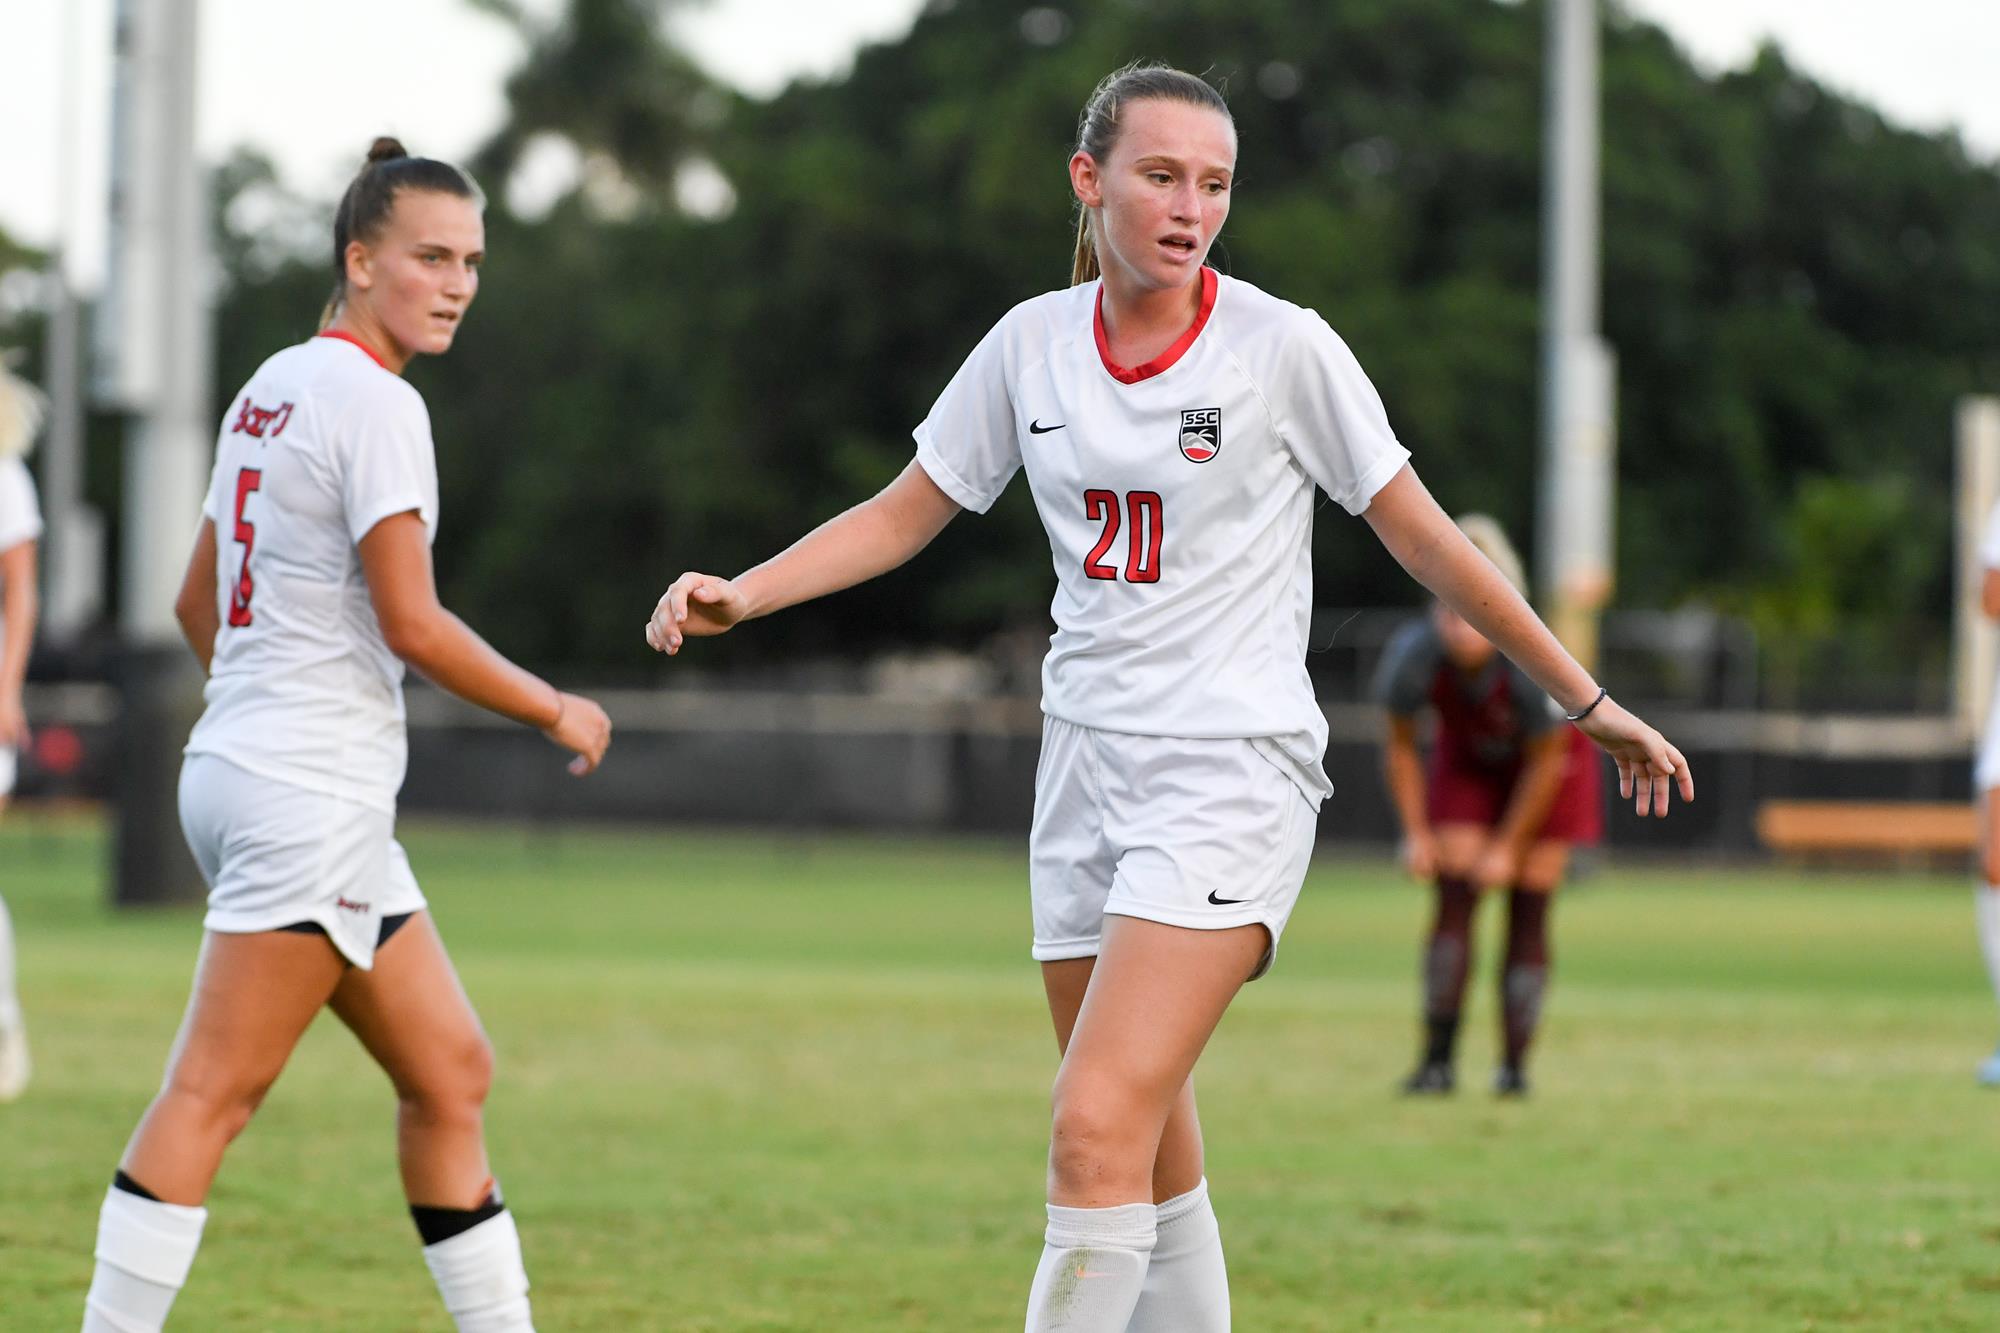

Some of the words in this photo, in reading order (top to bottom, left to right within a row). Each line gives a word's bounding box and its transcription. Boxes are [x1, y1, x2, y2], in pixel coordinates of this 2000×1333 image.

[1184, 412, 1217, 425] SSC
[228, 467, 262, 627] 5
[1083, 489, 1164, 583] 20
